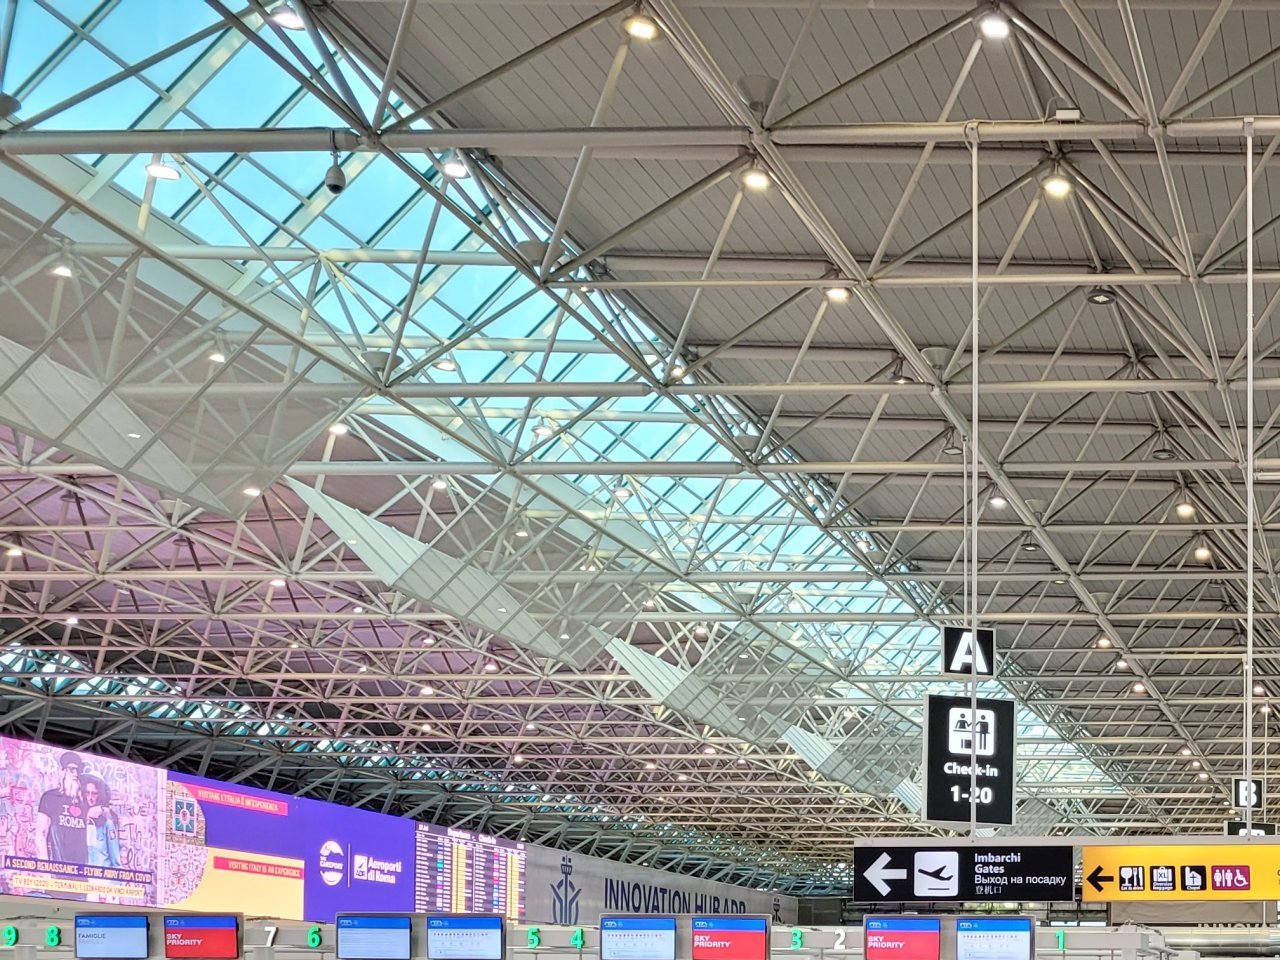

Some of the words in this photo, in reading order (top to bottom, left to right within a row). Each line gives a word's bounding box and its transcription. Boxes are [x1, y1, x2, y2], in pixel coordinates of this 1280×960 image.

[950, 632, 988, 672] A
[944, 762, 998, 777] Check-in
[1238, 780, 1257, 806] B
[62, 804, 69, 815] I
[59, 816, 85, 828] ROMA
[12, 860, 36, 870] SECOND
[368, 858, 402, 873] Aeroporti
[974, 852, 1021, 863] Imbarchi
[367, 869, 376, 881] di
[376, 872, 396, 884] Roma
[974, 863, 1004, 874] Gates
[974, 874, 1007, 887] Выход
[1010, 876, 1024, 884] на
[1026, 876, 1067, 887] посадку
[604, 878, 688, 914] INNOVATION
[692, 893, 721, 914] HUB
[3, 925, 18, 946] 9
[46, 925, 61, 947] 8
[264, 926, 279, 947] 7
[307, 926, 322, 948] 6
[527, 928, 541, 949] 5
[570, 928, 585, 949] 4
[790, 928, 804, 950] 3
[834, 928, 846, 950] 2
[1055, 929, 1065, 950] 1
